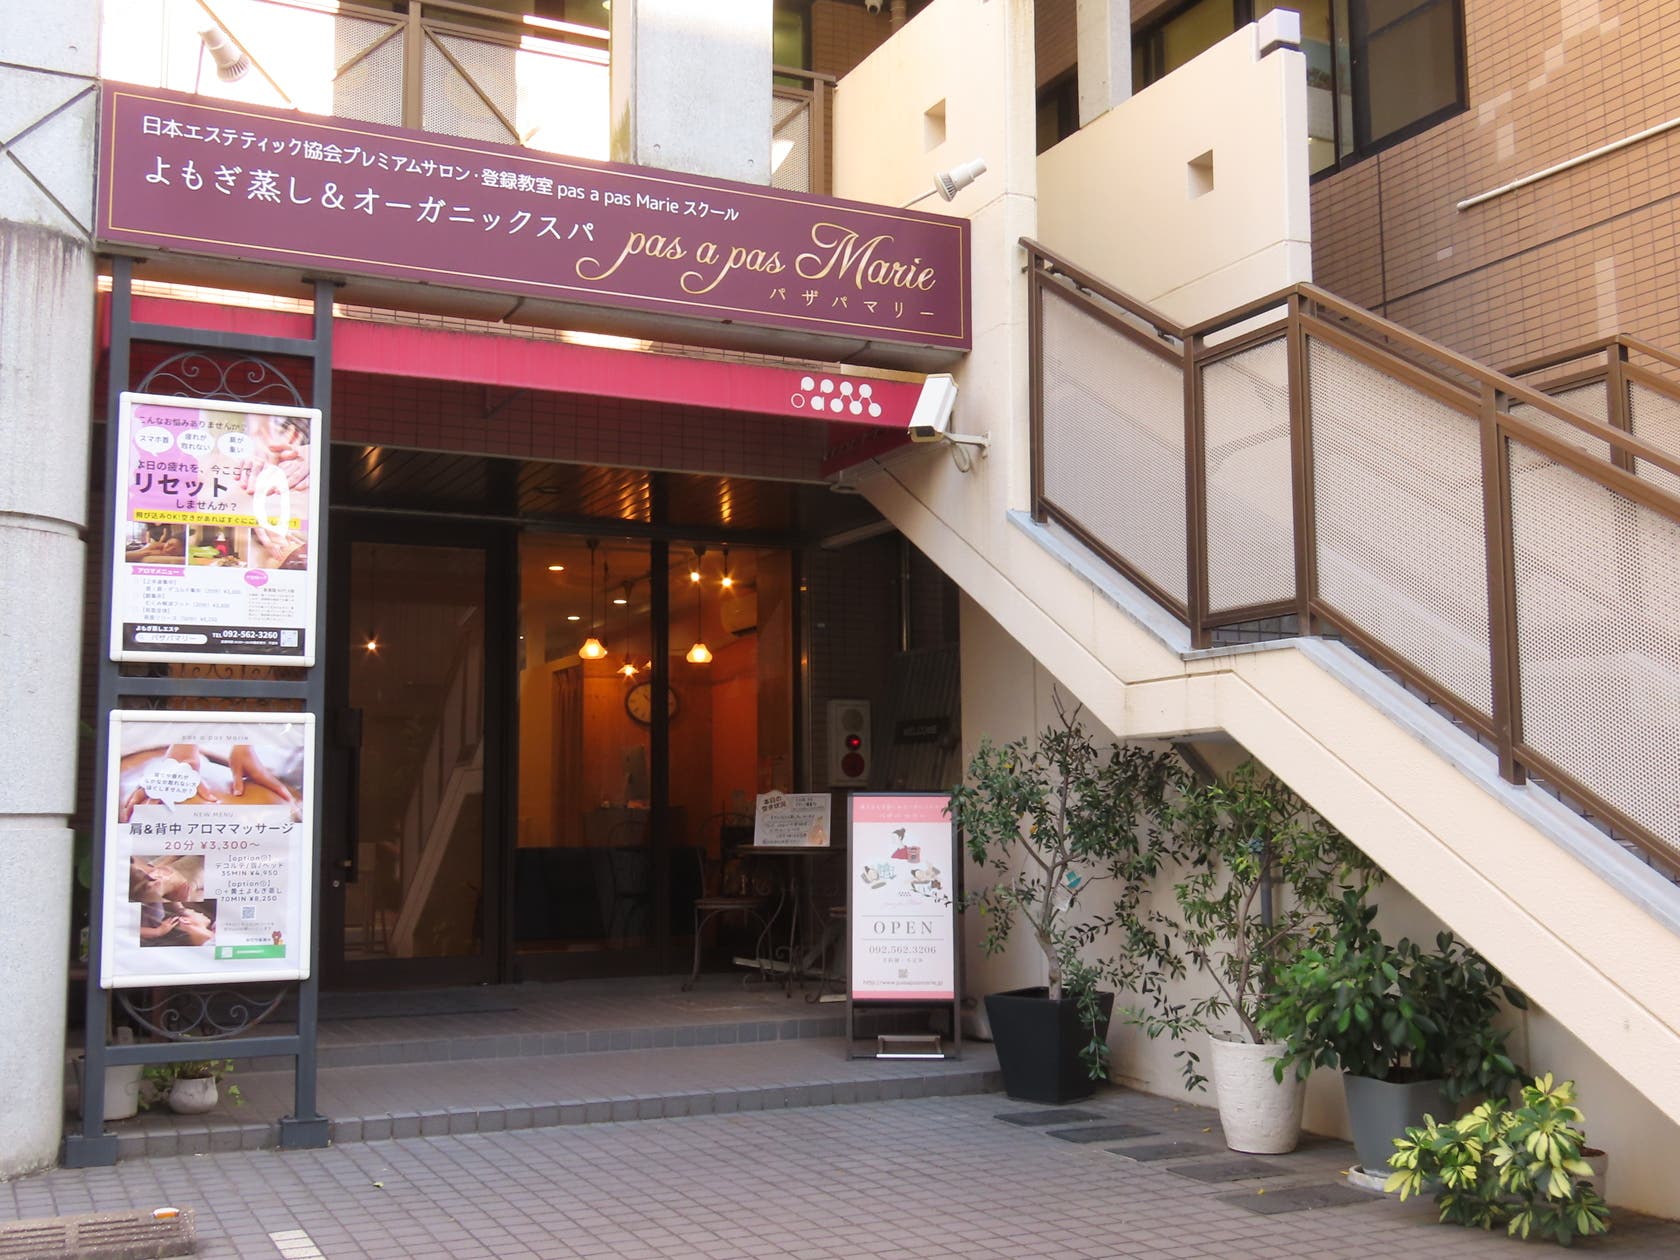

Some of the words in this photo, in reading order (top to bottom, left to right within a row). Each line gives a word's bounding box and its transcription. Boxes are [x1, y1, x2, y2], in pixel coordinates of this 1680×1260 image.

[557, 184, 585, 201] pas
[590, 190, 599, 202] a
[603, 190, 631, 208] pas
[635, 195, 679, 214] Marie
[683, 199, 740, 221] スクール
[576, 229, 686, 281] pas
[696, 240, 719, 263] a
[795, 222, 936, 291] Marie
[680, 245, 785, 295] pas
[770, 287, 935, 319] パザパマリー
[135, 472, 228, 498] リセット
[212, 632, 223, 640] TEL
[223, 630, 278, 642] 092-562-3260
[187, 822, 294, 836] アロママッサージ
[165, 840, 193, 851] 20分
[873, 920, 934, 935] OPEN
